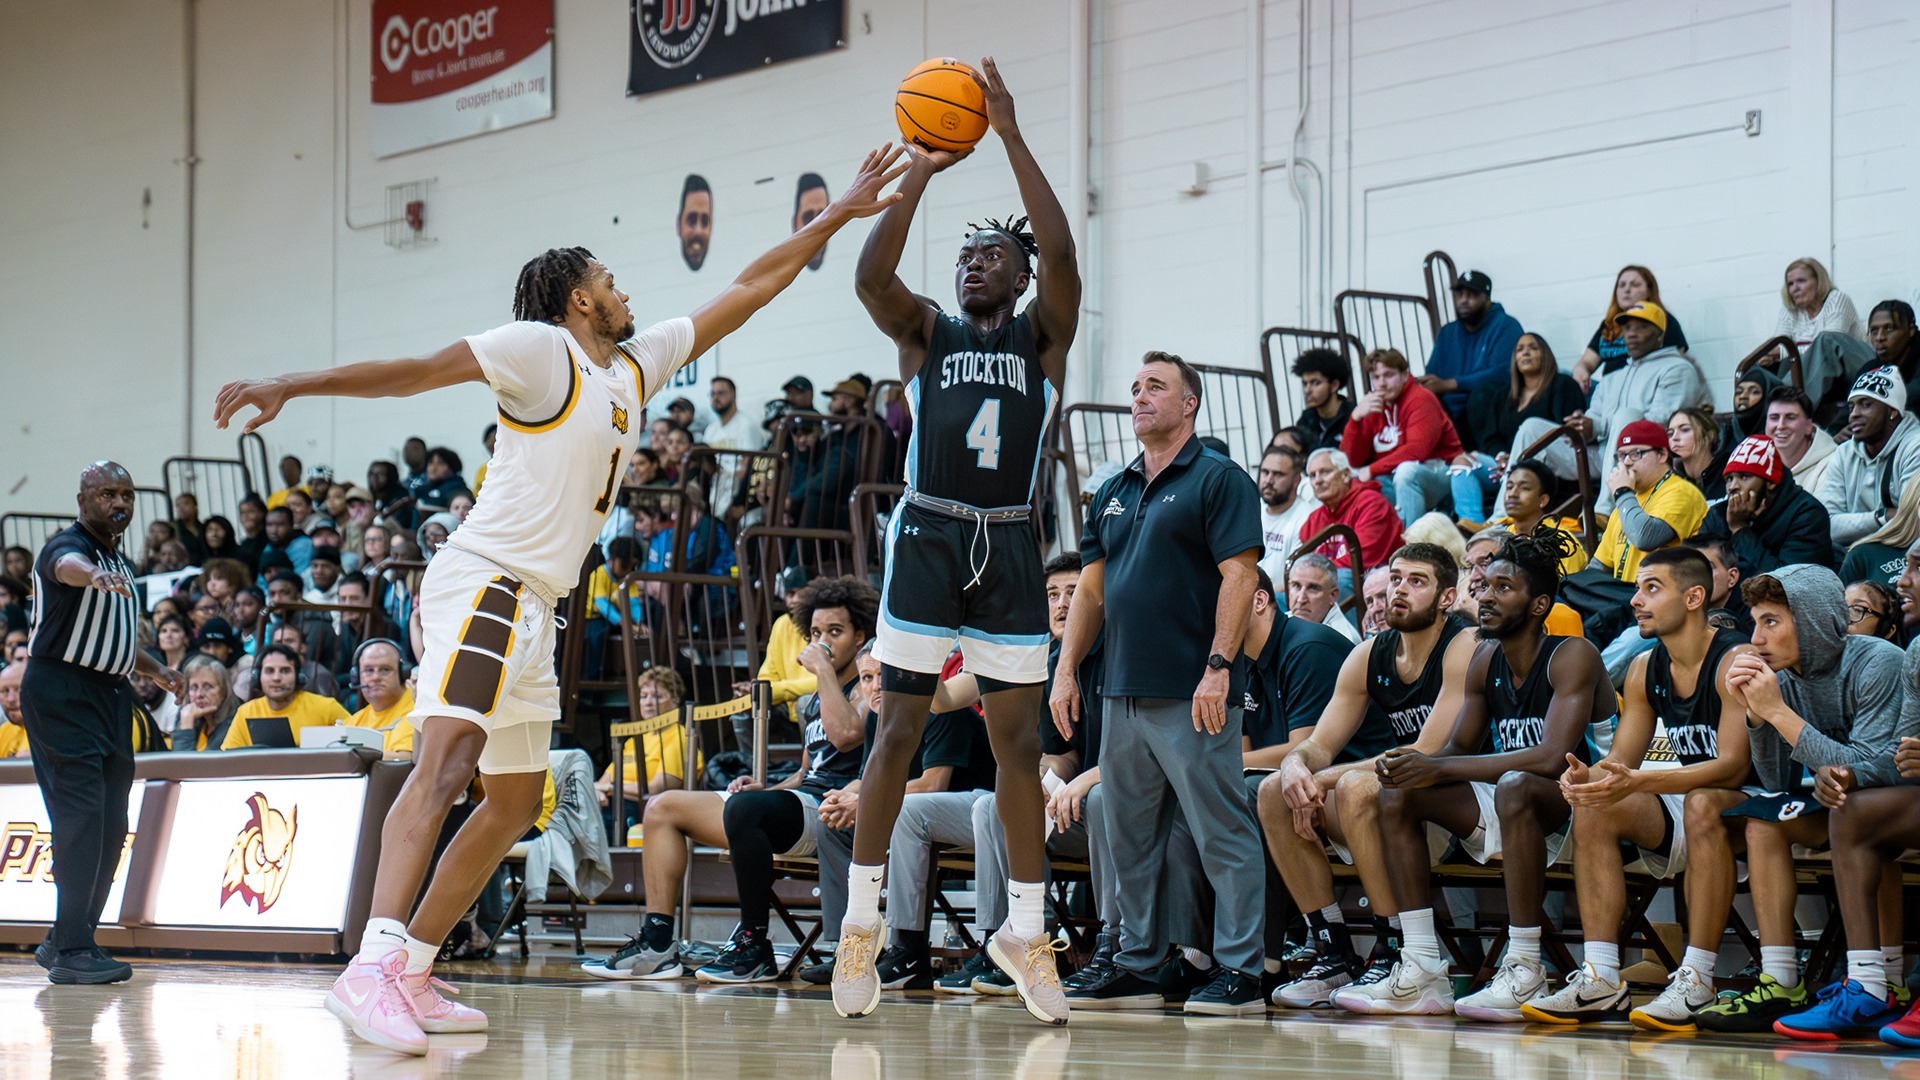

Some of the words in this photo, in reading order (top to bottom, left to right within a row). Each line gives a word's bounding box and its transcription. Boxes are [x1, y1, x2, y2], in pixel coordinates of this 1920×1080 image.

[411, 6, 499, 57] Cooper
[455, 76, 545, 112] cooperhealth.org
[940, 351, 1027, 397] STOCKTON
[965, 398, 1001, 470] 4
[594, 446, 621, 515] 1
